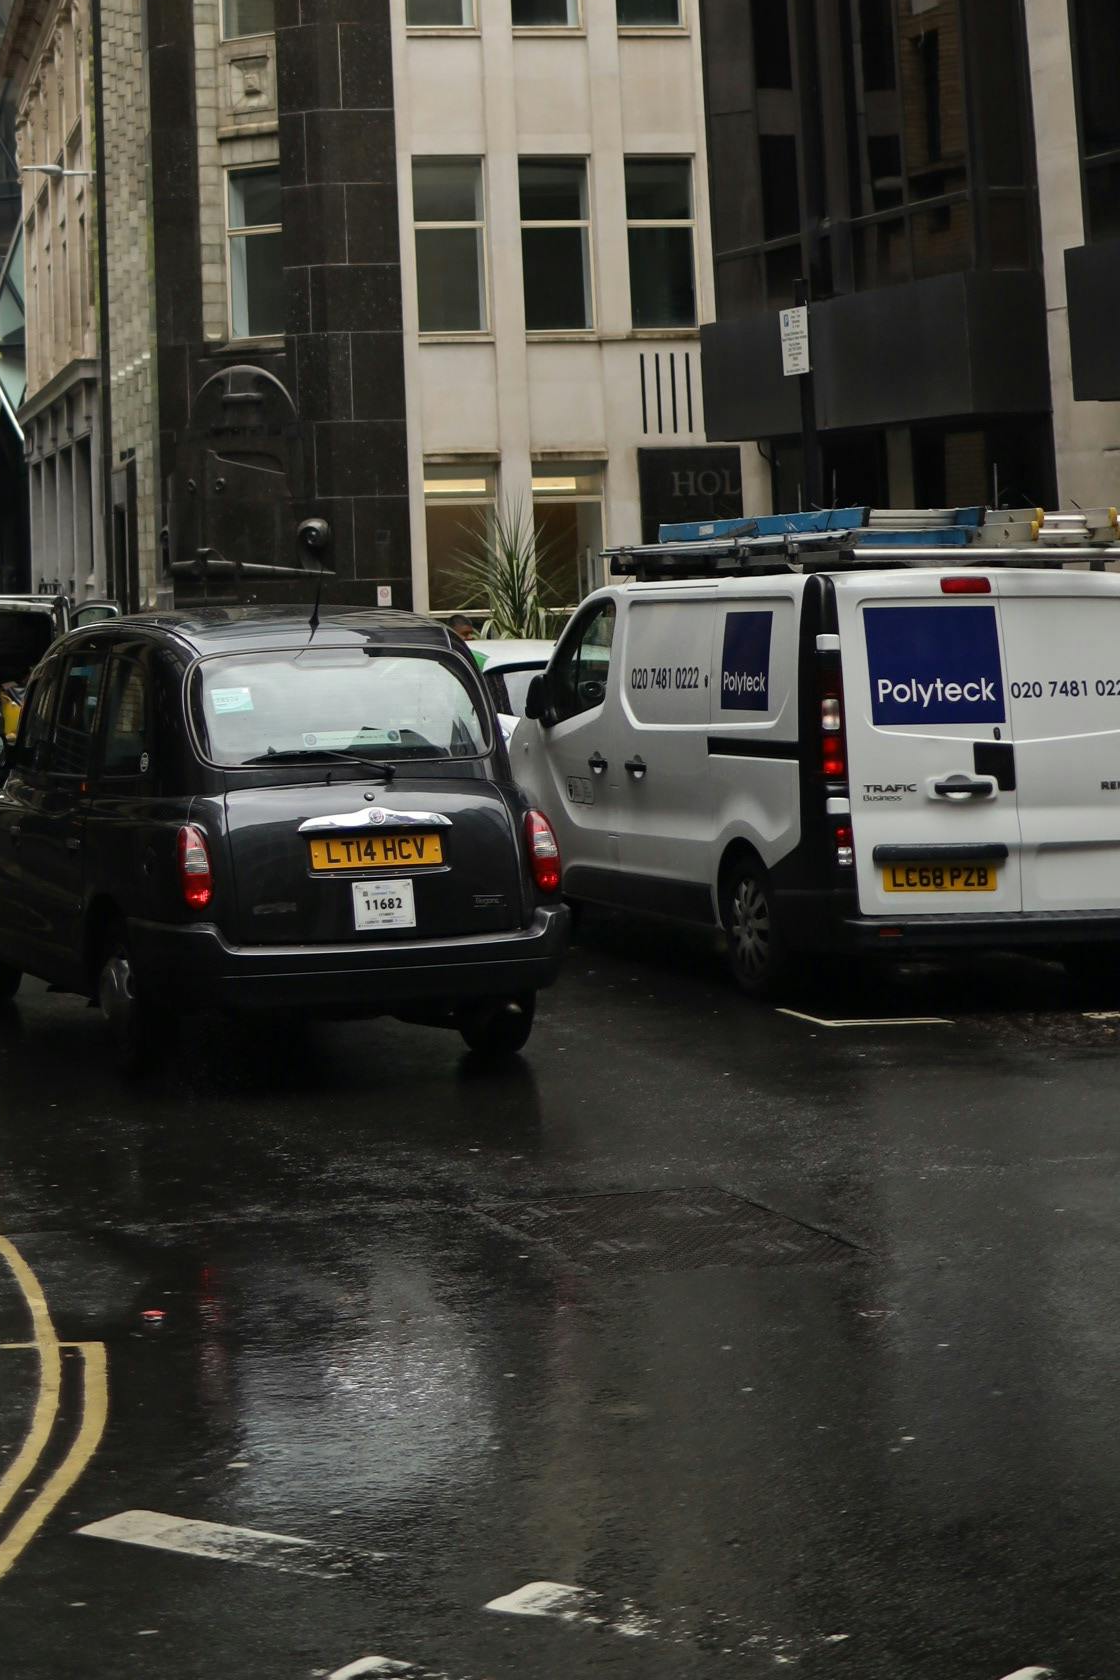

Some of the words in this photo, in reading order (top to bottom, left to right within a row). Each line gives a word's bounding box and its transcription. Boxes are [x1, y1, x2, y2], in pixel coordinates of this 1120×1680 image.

[672, 469, 741, 496] HOL
[631, 668, 648, 689] 020
[651, 668, 672, 689] 7481
[675, 666, 700, 689] 0222
[723, 671, 766, 695] Polyteck
[877, 677, 996, 708] Polyteck
[1011, 681, 1043, 699] 020
[1048, 680, 1088, 697] 7481
[863, 783, 918, 793] TRAFIC
[1100, 780, 1120, 790] RE
[325, 839, 377, 864] LT14
[382, 837, 425, 861] HCV
[892, 867, 945, 888] LC68
[949, 866, 989, 887] PZB
[365, 897, 403, 911] 11682
